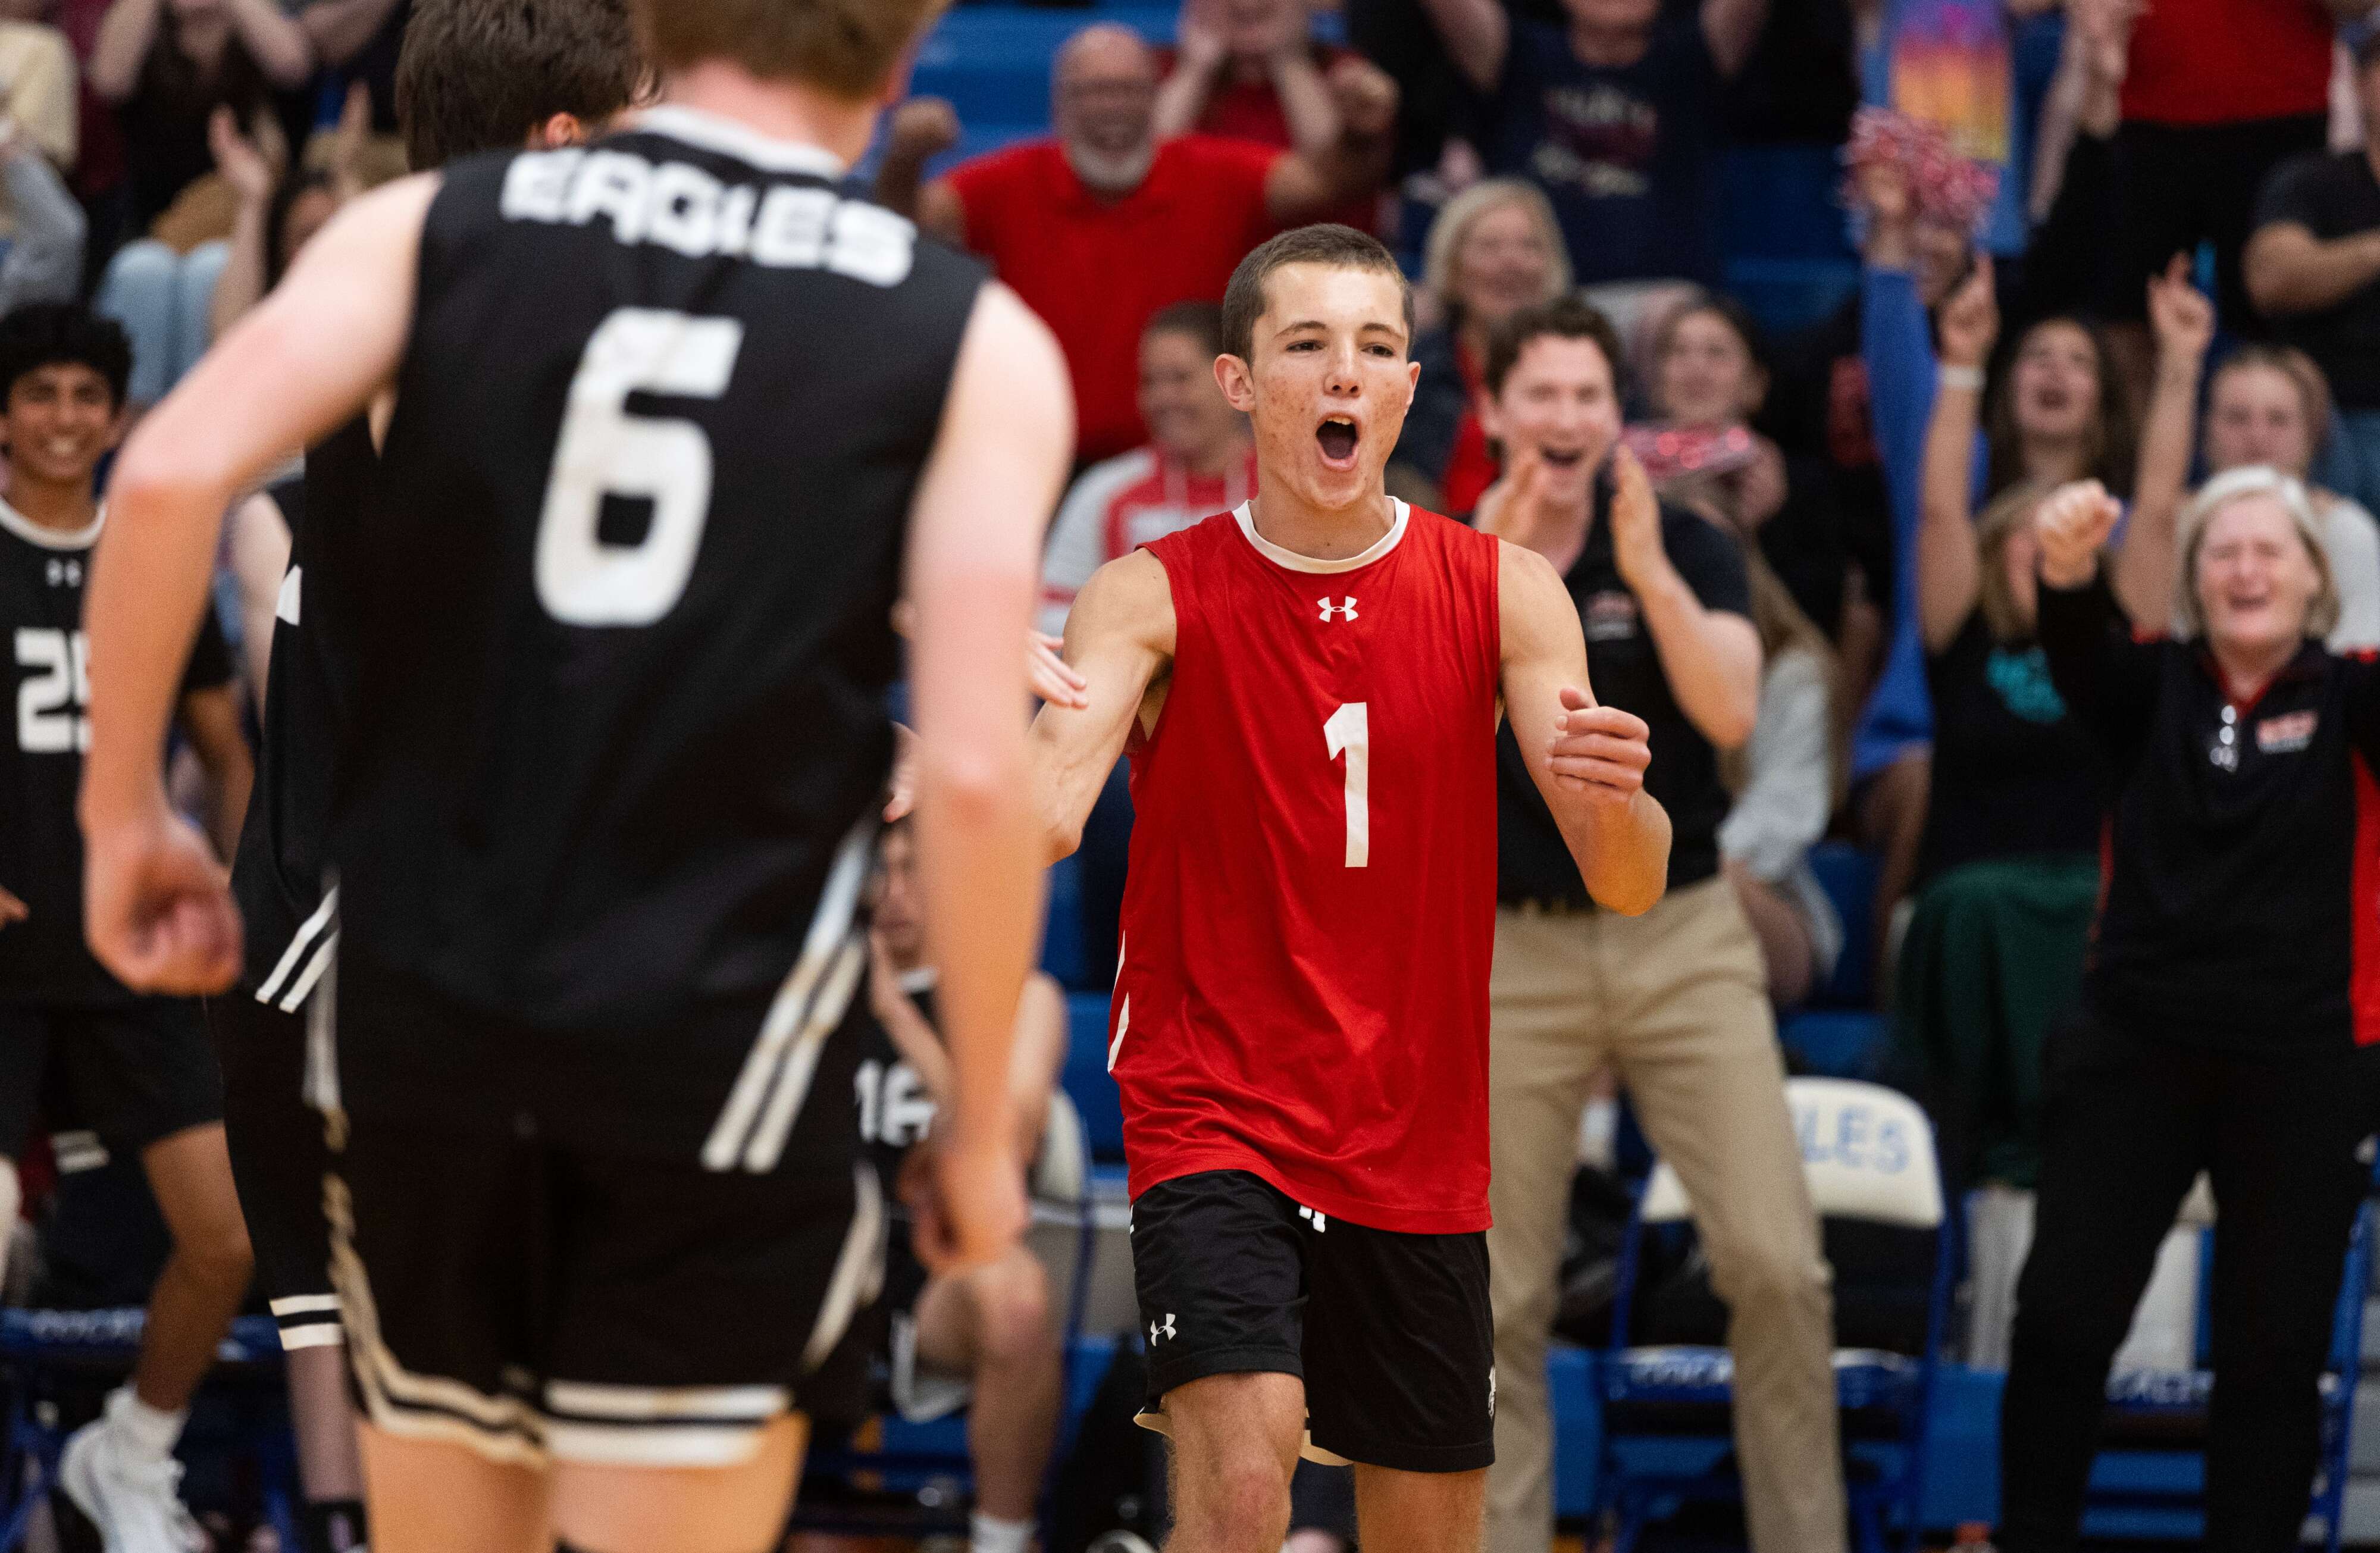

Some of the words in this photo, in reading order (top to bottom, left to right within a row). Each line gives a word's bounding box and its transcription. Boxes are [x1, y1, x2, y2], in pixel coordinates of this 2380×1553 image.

[502, 149, 917, 286] EAGLES
[534, 308, 742, 627] 6
[1323, 702, 1368, 868] 1
[1800, 1106, 1909, 1173] LES
